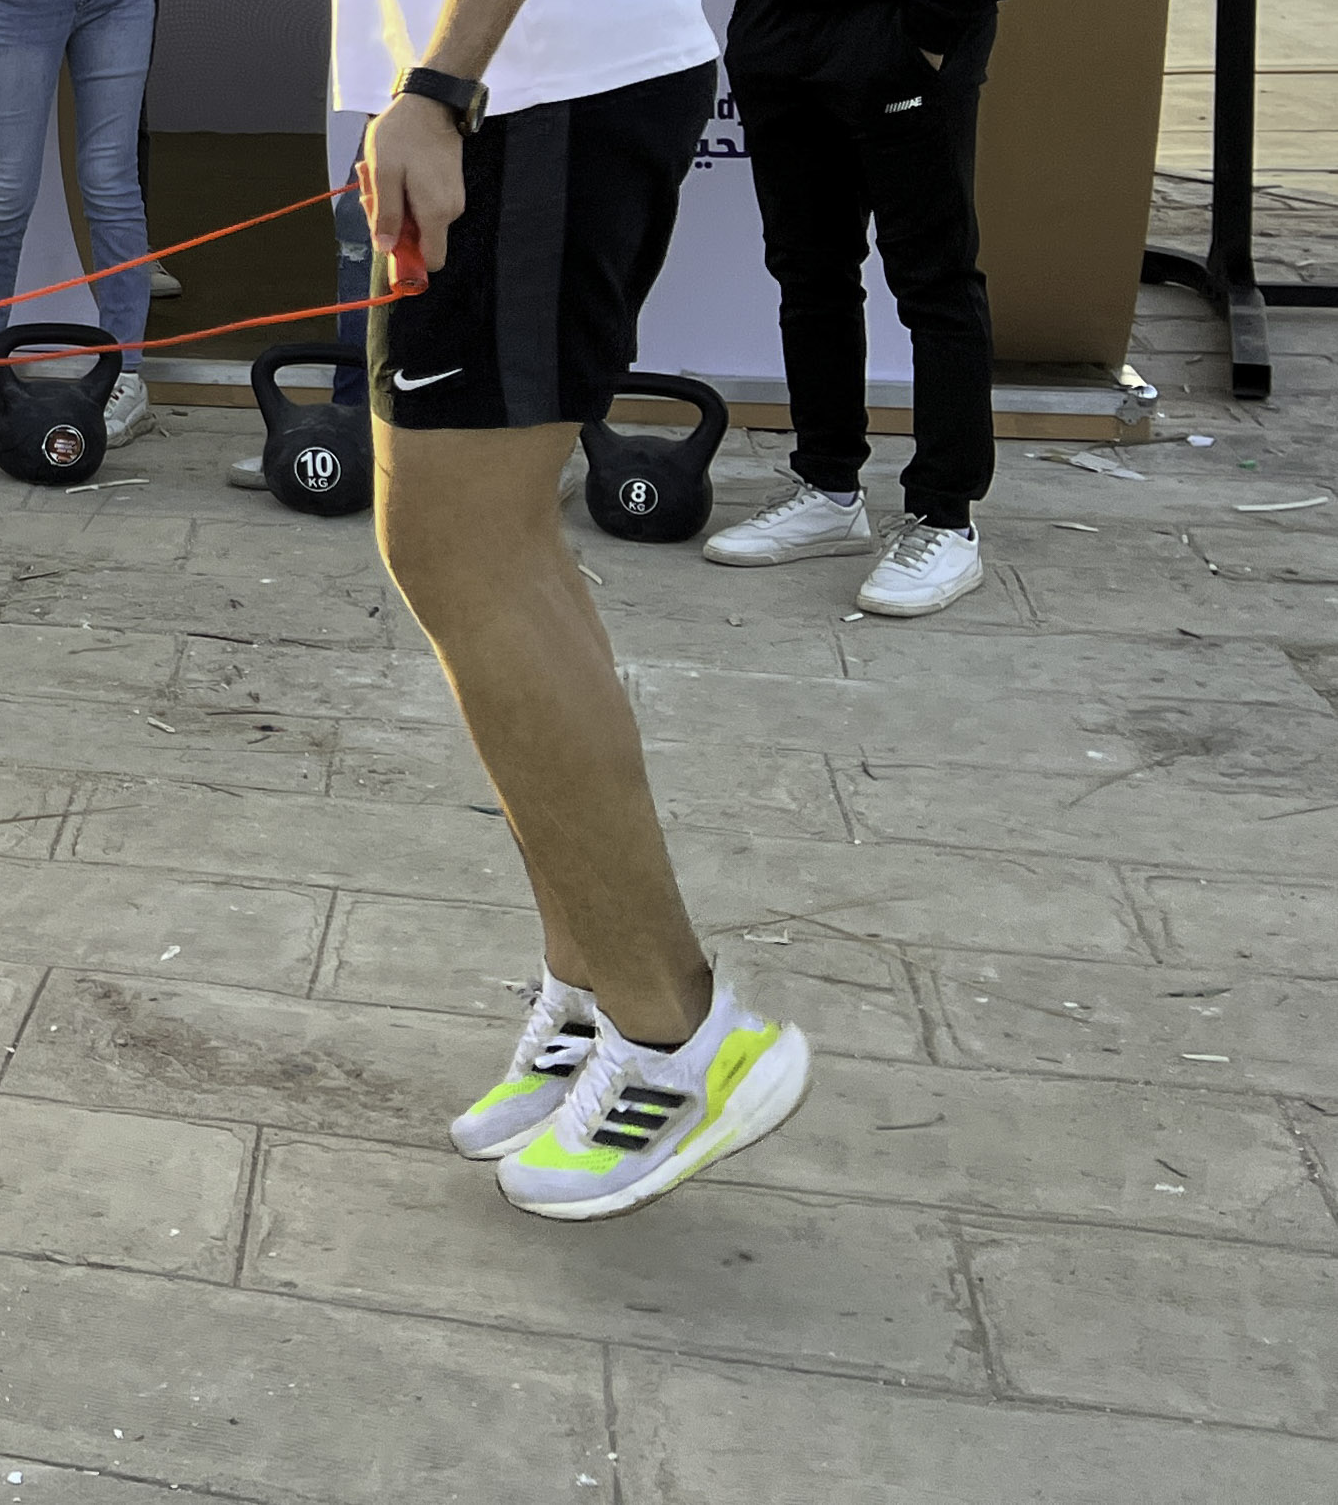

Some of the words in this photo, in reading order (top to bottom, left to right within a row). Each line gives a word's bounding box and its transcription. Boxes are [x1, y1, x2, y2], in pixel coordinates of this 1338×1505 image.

[300, 451, 334, 477] 10
[308, 477, 329, 488] KG
[631, 482, 646, 503] 8
[628, 501, 646, 512] KG
